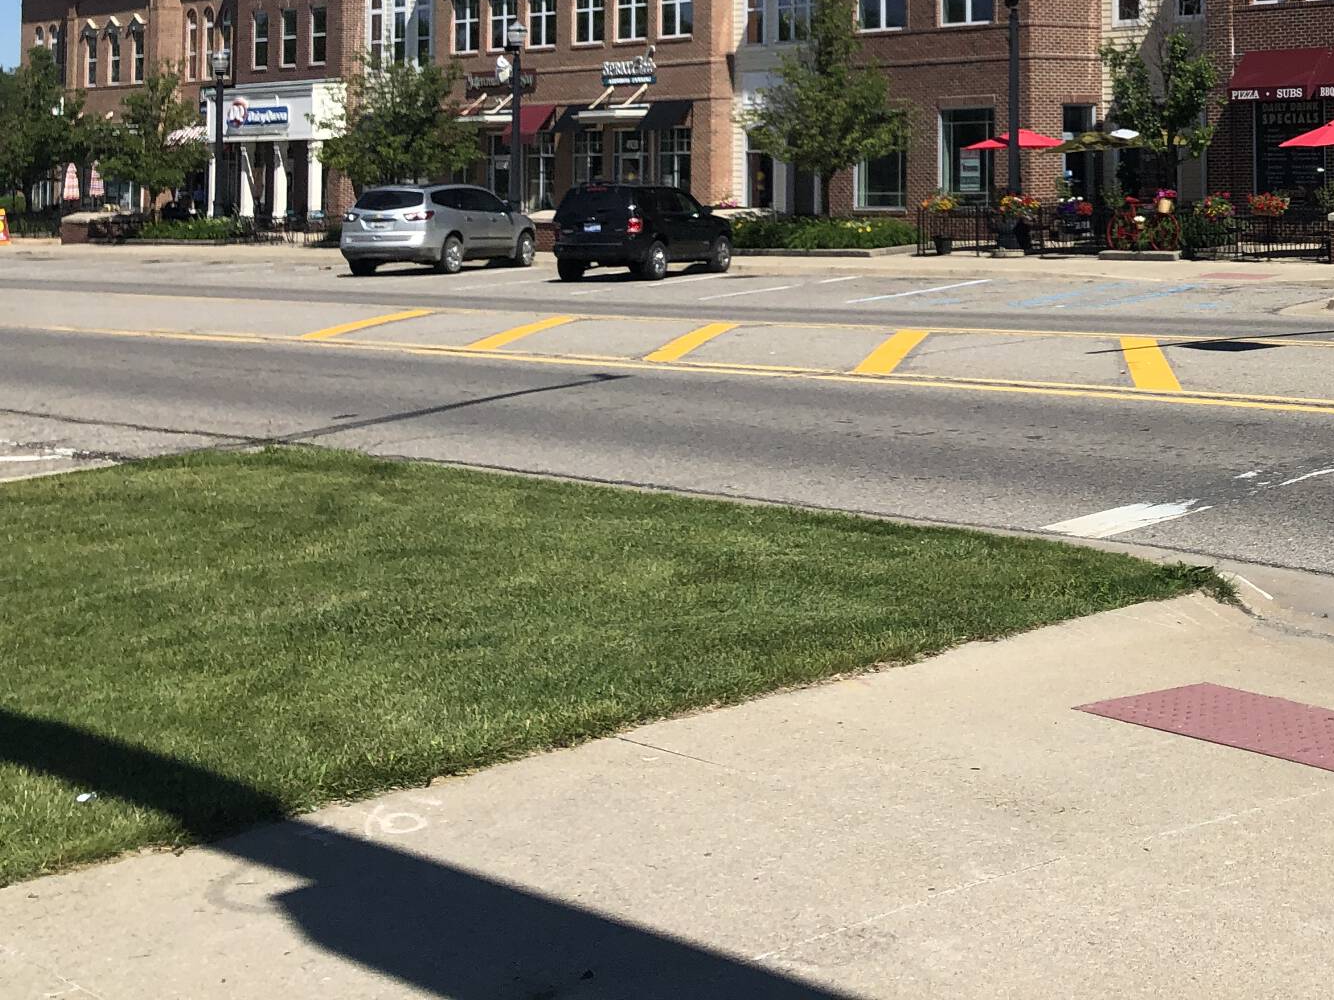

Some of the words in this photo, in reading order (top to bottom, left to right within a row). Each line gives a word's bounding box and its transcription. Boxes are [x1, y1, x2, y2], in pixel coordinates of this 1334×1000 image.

[1231, 89, 1260, 100] PIZZA
[1276, 87, 1303, 98] SUBS
[1262, 112, 1320, 125] SPECIALS
